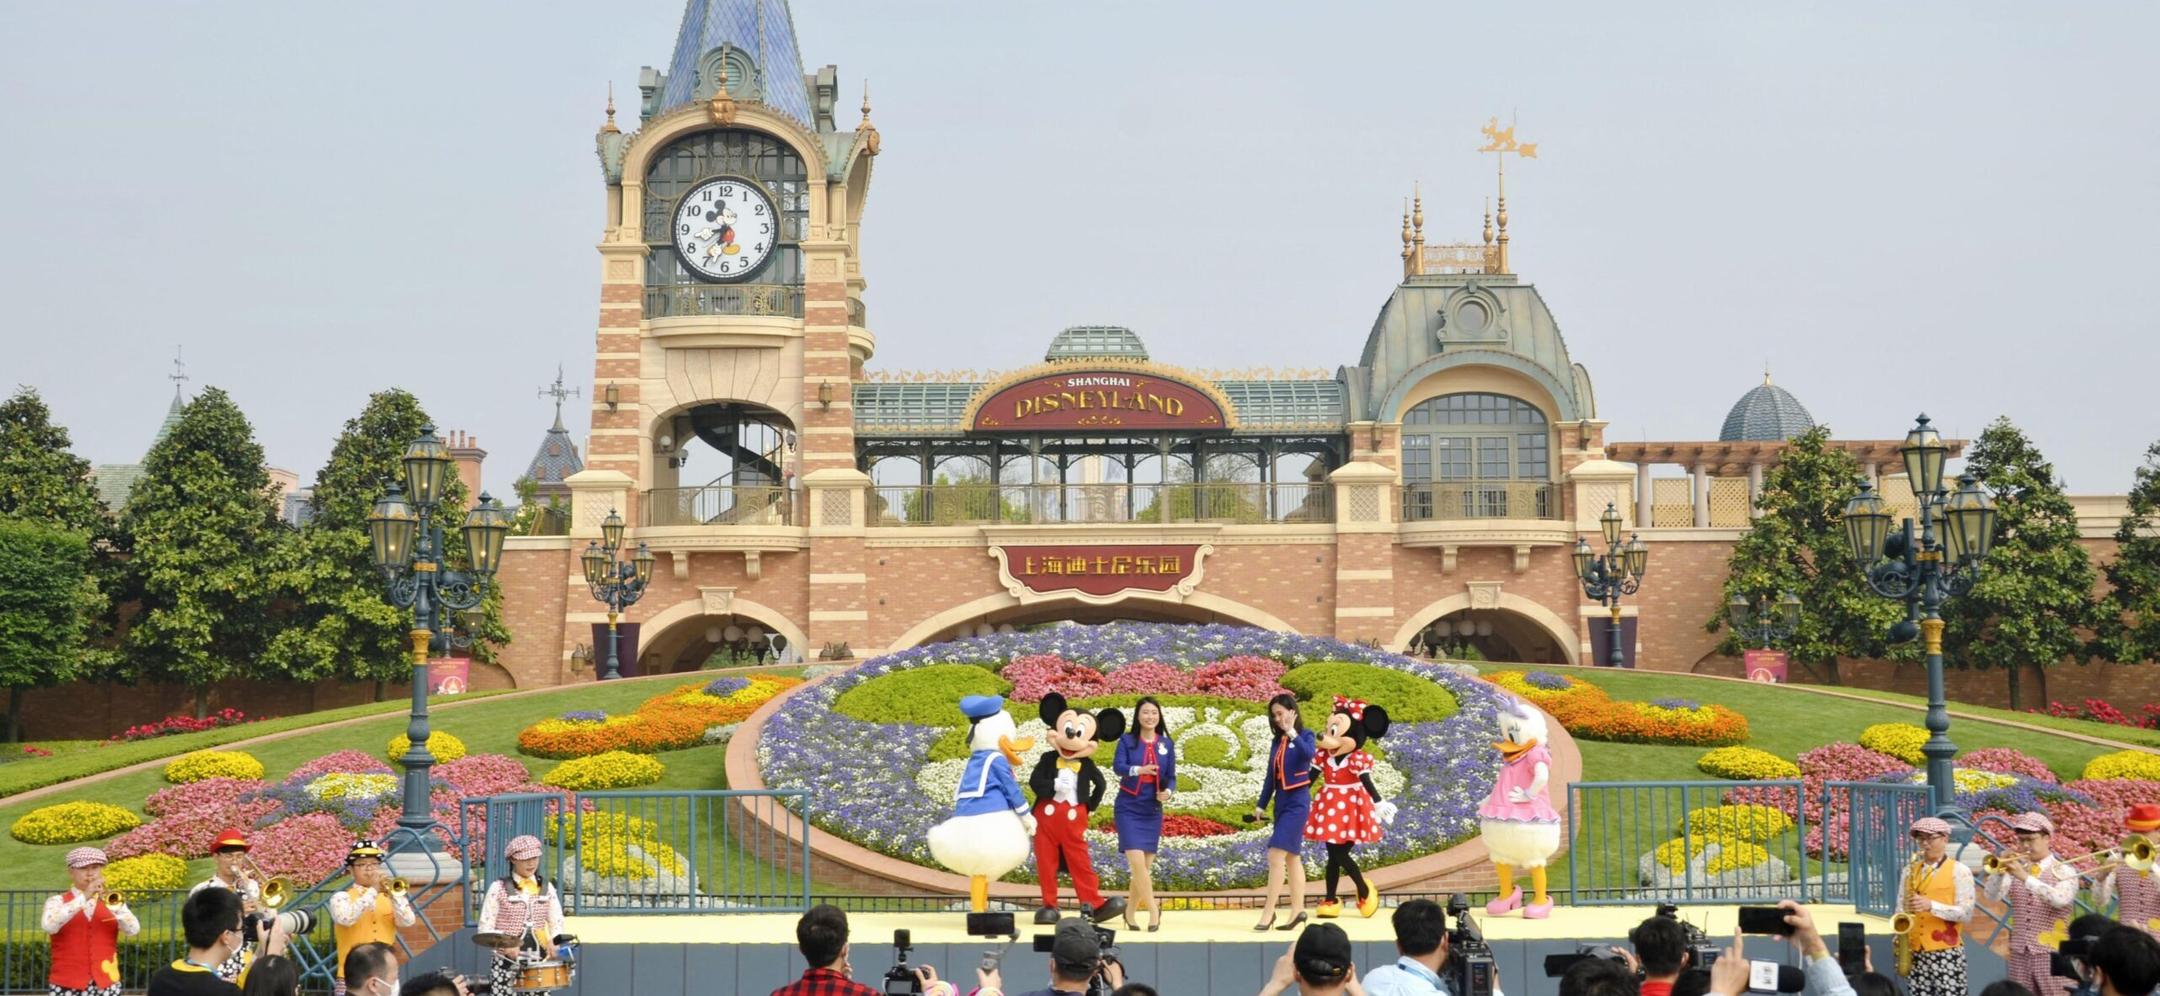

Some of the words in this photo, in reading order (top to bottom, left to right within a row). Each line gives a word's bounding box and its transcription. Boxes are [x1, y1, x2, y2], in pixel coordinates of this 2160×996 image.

[703, 191, 712, 201] 11
[720, 186, 733, 197] 12
[687, 205, 701, 216] 10
[755, 204, 764, 215] 2
[681, 224, 690, 235] 9
[760, 223, 769, 234] 3
[687, 243, 696, 254] 8
[755, 243, 763, 253] 4
[702, 256, 711, 267] 7
[720, 261, 729, 272] 6
[740, 257, 749, 267] 5
[1067, 377, 1130, 387] SHANGHAI
[1015, 390, 1184, 418] DISNEYLAND
[1018, 555, 1181, 575] 上海迪士尼乐园
